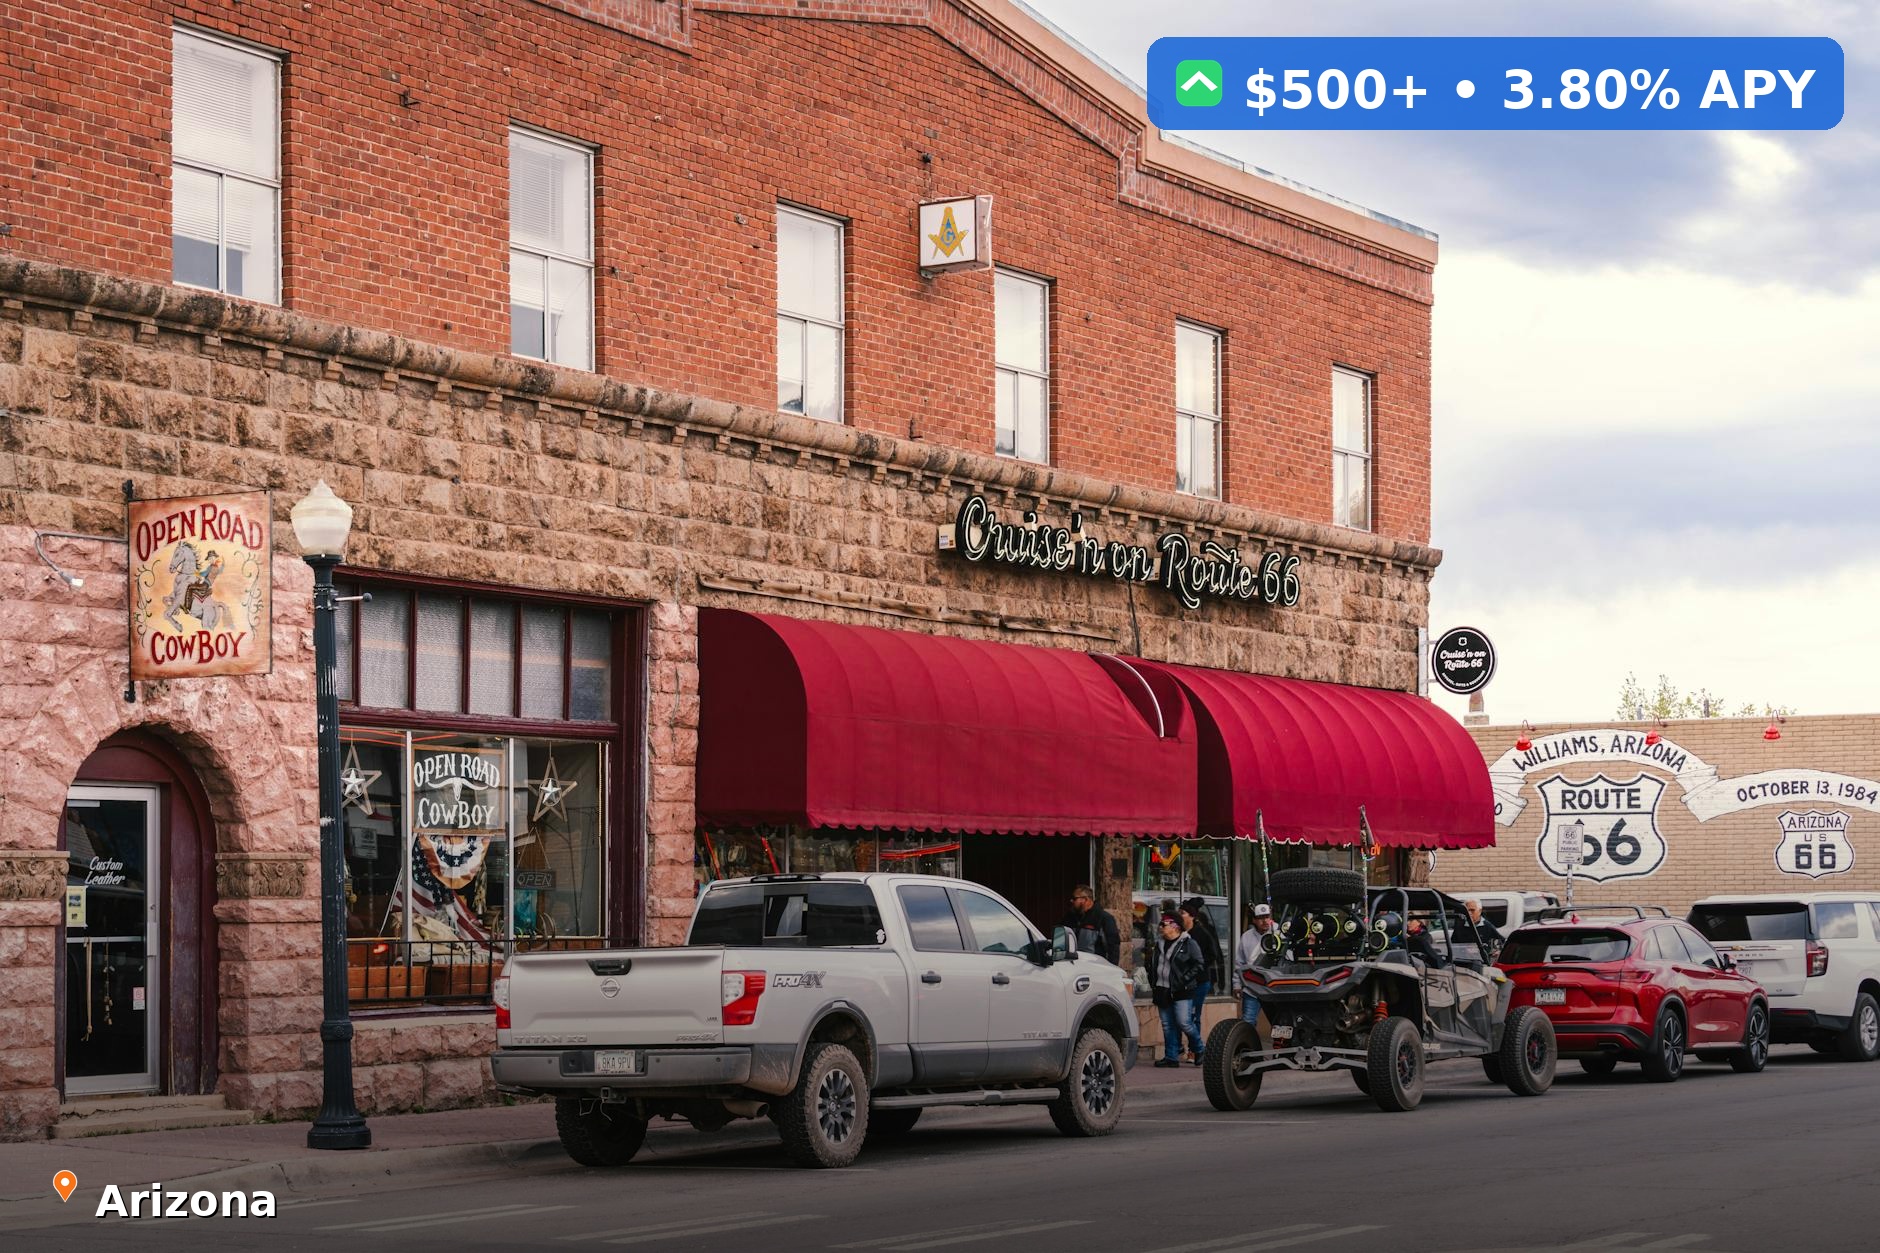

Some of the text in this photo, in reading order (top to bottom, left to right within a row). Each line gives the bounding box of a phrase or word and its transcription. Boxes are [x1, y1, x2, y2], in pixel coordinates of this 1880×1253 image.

[136, 503, 264, 561] OPEN ROAD
[957, 495, 1300, 609] Cruise'n on Route 66
[151, 630, 246, 665] COWBOY
[1440, 649, 1473, 659] Cruise'n
[1444, 659, 1483, 671] Route 66
[1512, 735, 1687, 772] WILLIAMS, ARIZONA
[413, 753, 501, 788] OPEN ROAD
[1561, 788, 1641, 810] ROUTE
[1737, 781, 1809, 801] OCTOBER
[1838, 783, 1878, 804] 1984
[418, 798, 495, 829] COWBOY
[1788, 816, 1842, 828] ARIZONA
[89, 856, 123, 871] Custom
[1795, 844, 1836, 869] 66
[84, 871, 126, 885] Leather
[517, 873, 552, 887] OPEN
